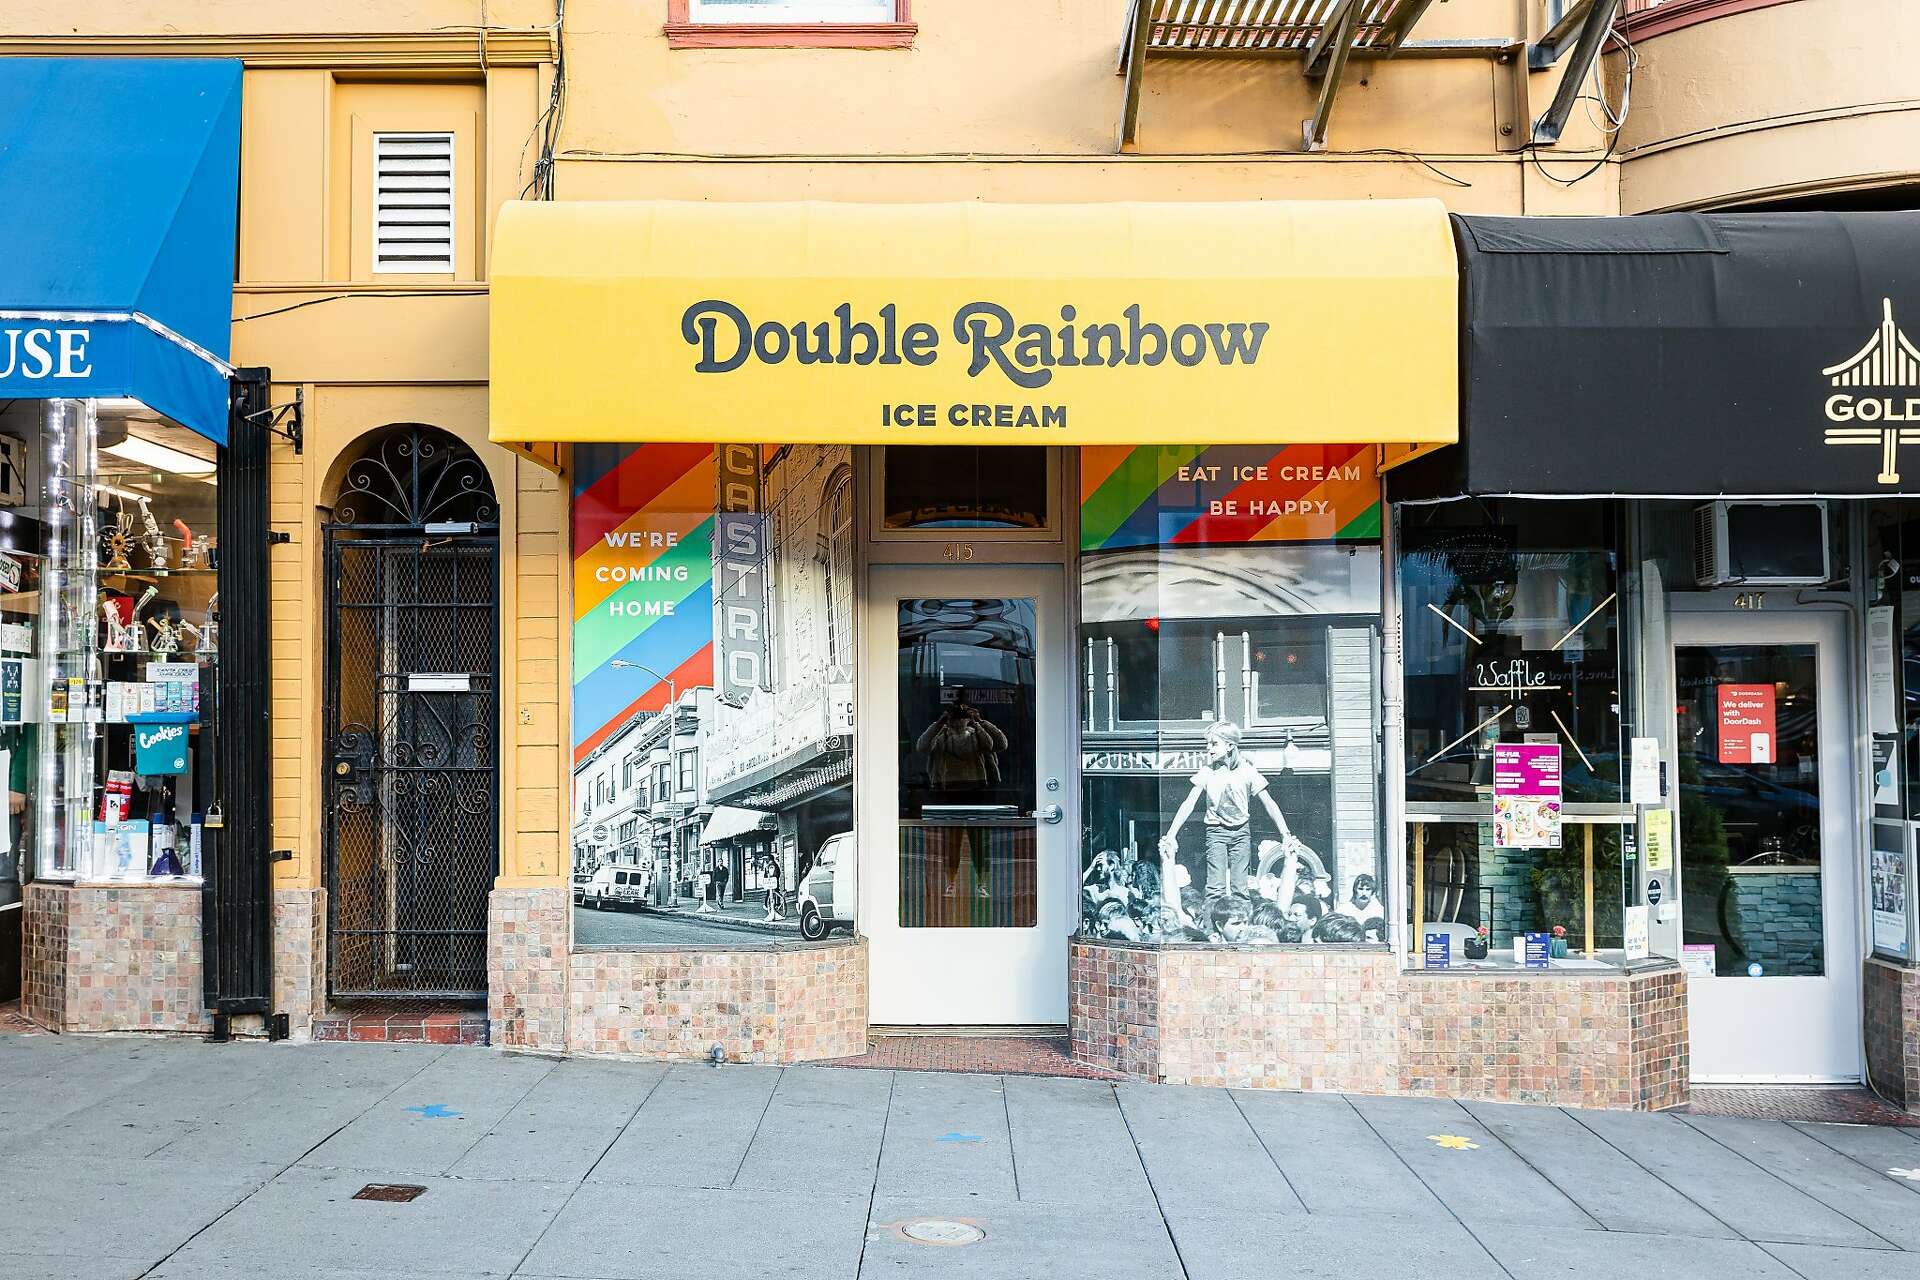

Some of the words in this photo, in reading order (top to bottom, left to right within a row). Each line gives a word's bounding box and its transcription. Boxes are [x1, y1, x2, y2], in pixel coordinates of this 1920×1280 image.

[681, 300, 939, 373] Double
[953, 302, 1270, 389] Rainbow
[882, 404, 936, 427] ICE
[948, 404, 1067, 428] CREAM
[1178, 466, 1221, 482] EAT
[1233, 466, 1269, 481] ICE
[1280, 466, 1361, 481] CREAM
[1210, 501, 1238, 516] BE
[1250, 501, 1329, 516] HAPPY
[604, 532, 678, 548] WE'RE
[943, 544, 974, 561] 415
[595, 566, 688, 582] COMING
[724, 444, 761, 688] CASTRO
[609, 601, 675, 616] HOME
[1734, 591, 1765, 610] 417
[1477, 659, 1546, 700] Waffle
[1723, 700, 1737, 708] We
[1738, 700, 1764, 708] deliver
[1723, 709, 1740, 717] with
[139, 726, 183, 748] Cookies
